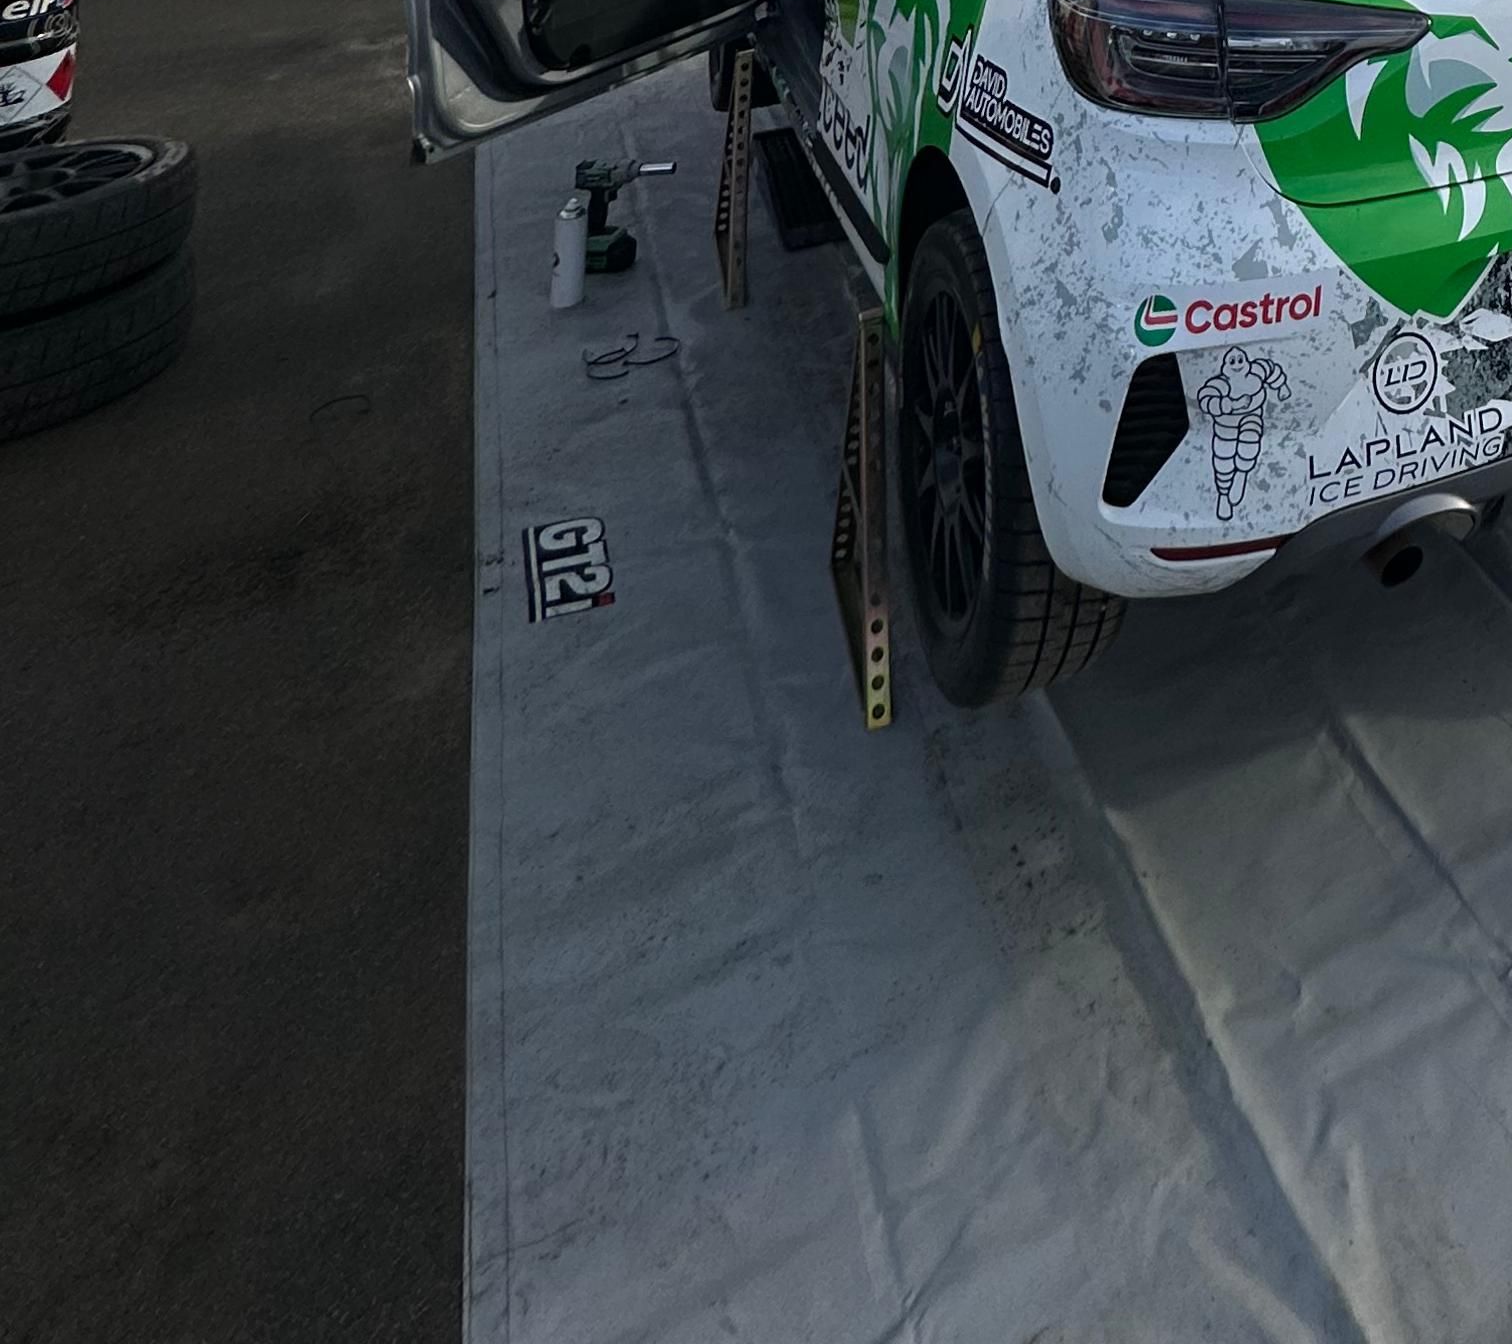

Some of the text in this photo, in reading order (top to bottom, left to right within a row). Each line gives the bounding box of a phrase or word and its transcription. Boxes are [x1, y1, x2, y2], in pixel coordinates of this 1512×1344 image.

[972, 60, 1006, 99] DAVID
[964, 85, 1051, 155] AUTOMOBILES
[1184, 285, 1322, 335] Castrol
[1308, 407, 1503, 480] LAPLAND
[1308, 436, 1502, 506] ICE DRIVING
